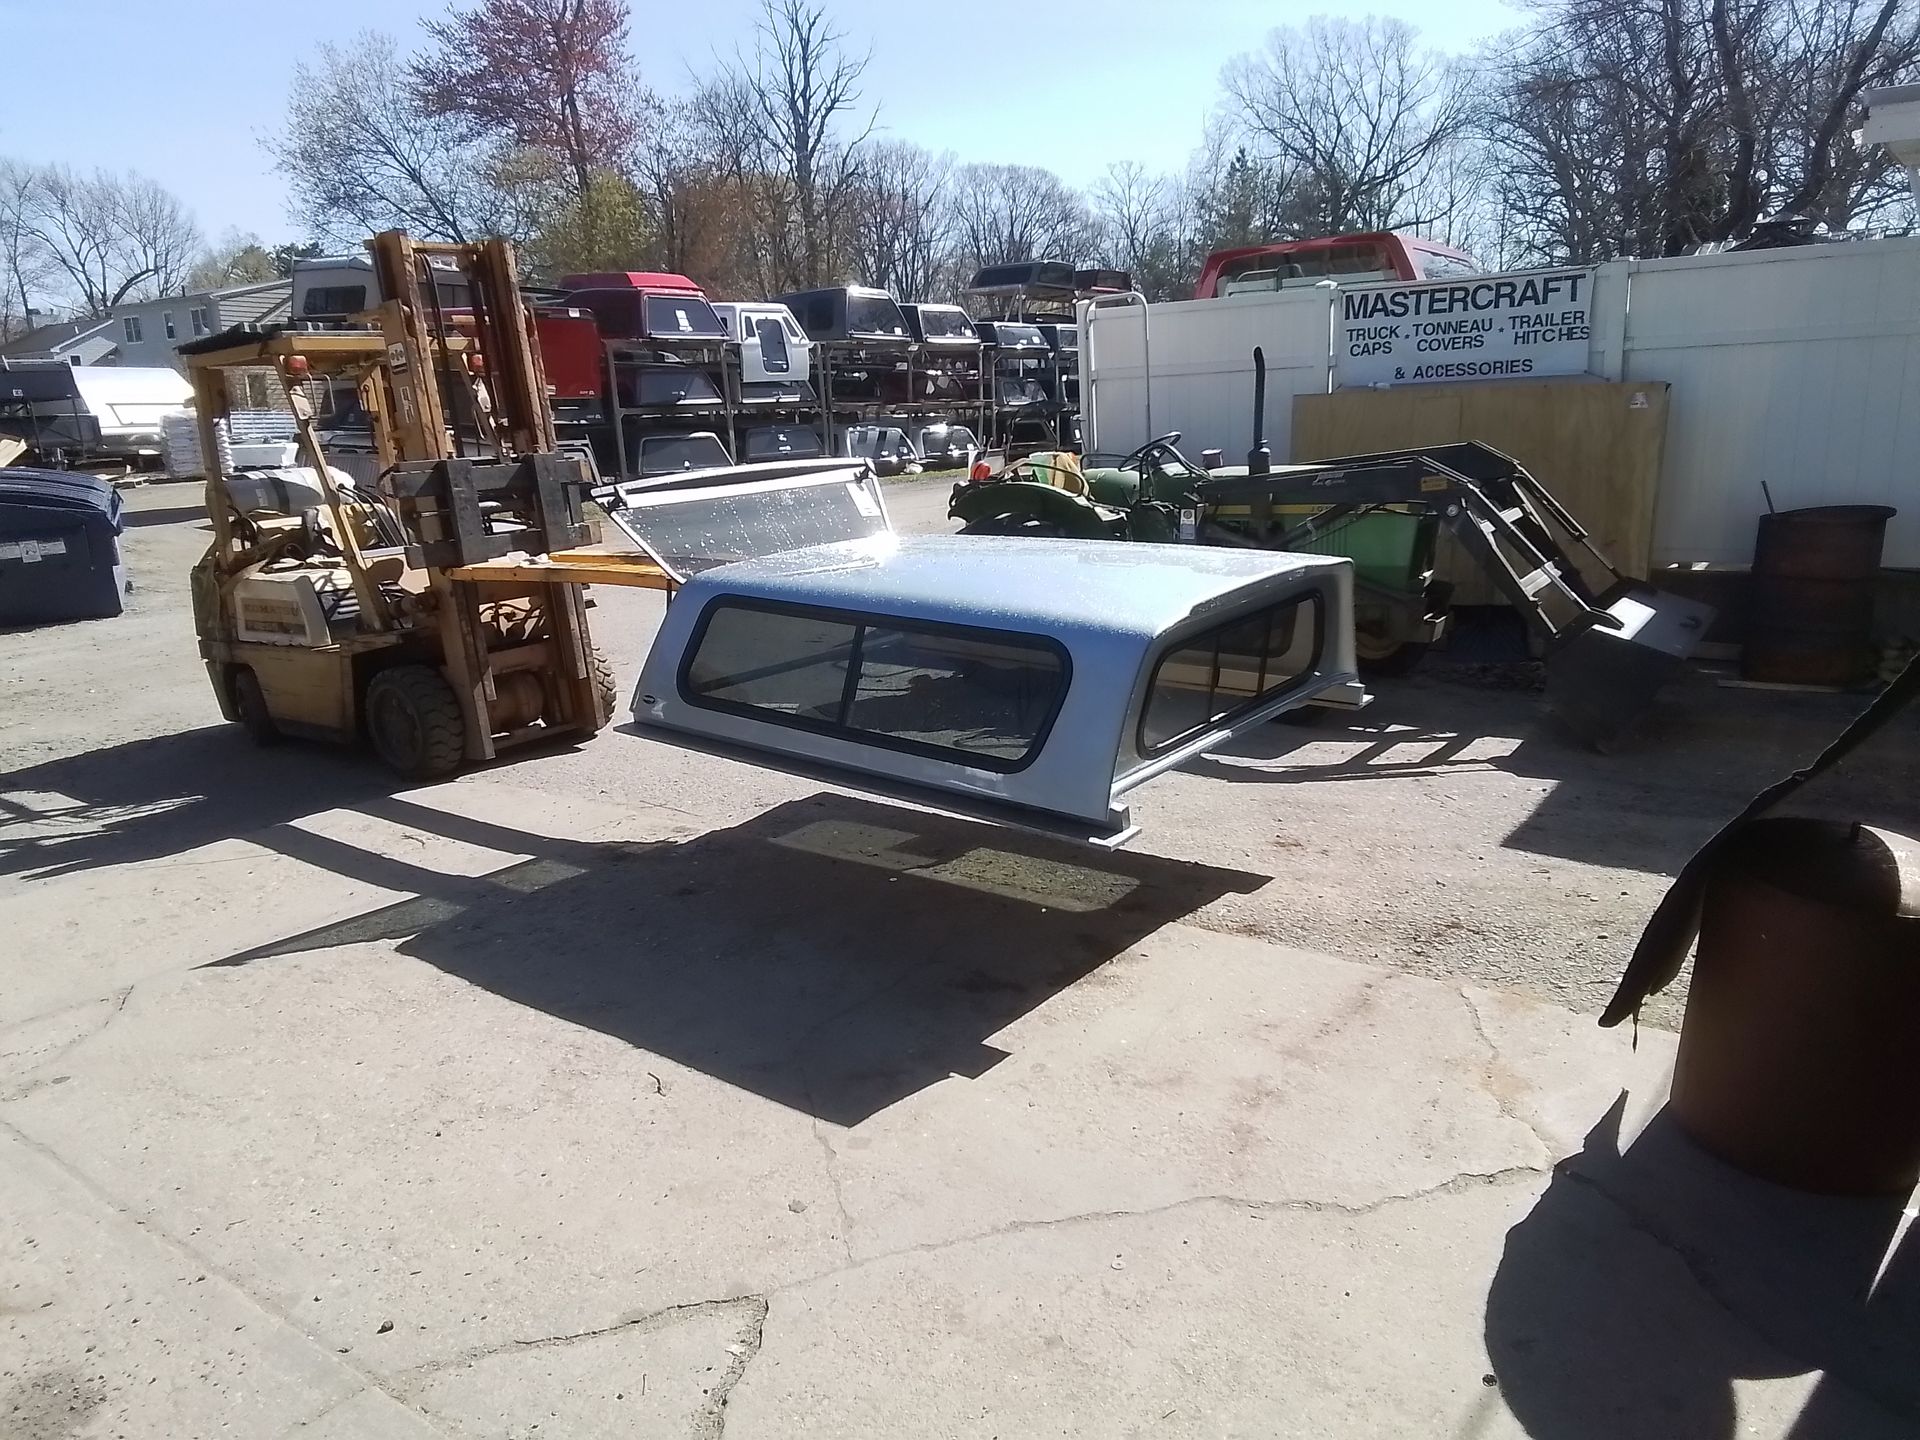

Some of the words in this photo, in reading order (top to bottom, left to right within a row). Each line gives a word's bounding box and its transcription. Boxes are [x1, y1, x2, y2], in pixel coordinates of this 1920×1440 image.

[1344, 273, 1586, 320] MASTERCRAFT
[1346, 325, 1401, 342] TRUCK
[1412, 318, 1493, 337] TONNEAU
[1508, 310, 1585, 330] TRAILER
[1350, 341, 1393, 357] CAPS
[1416, 334, 1484, 352] COVERS
[1514, 326, 1590, 345] HITCHES
[1394, 366, 1405, 379] &
[1413, 358, 1533, 379] ACCESSORIES
